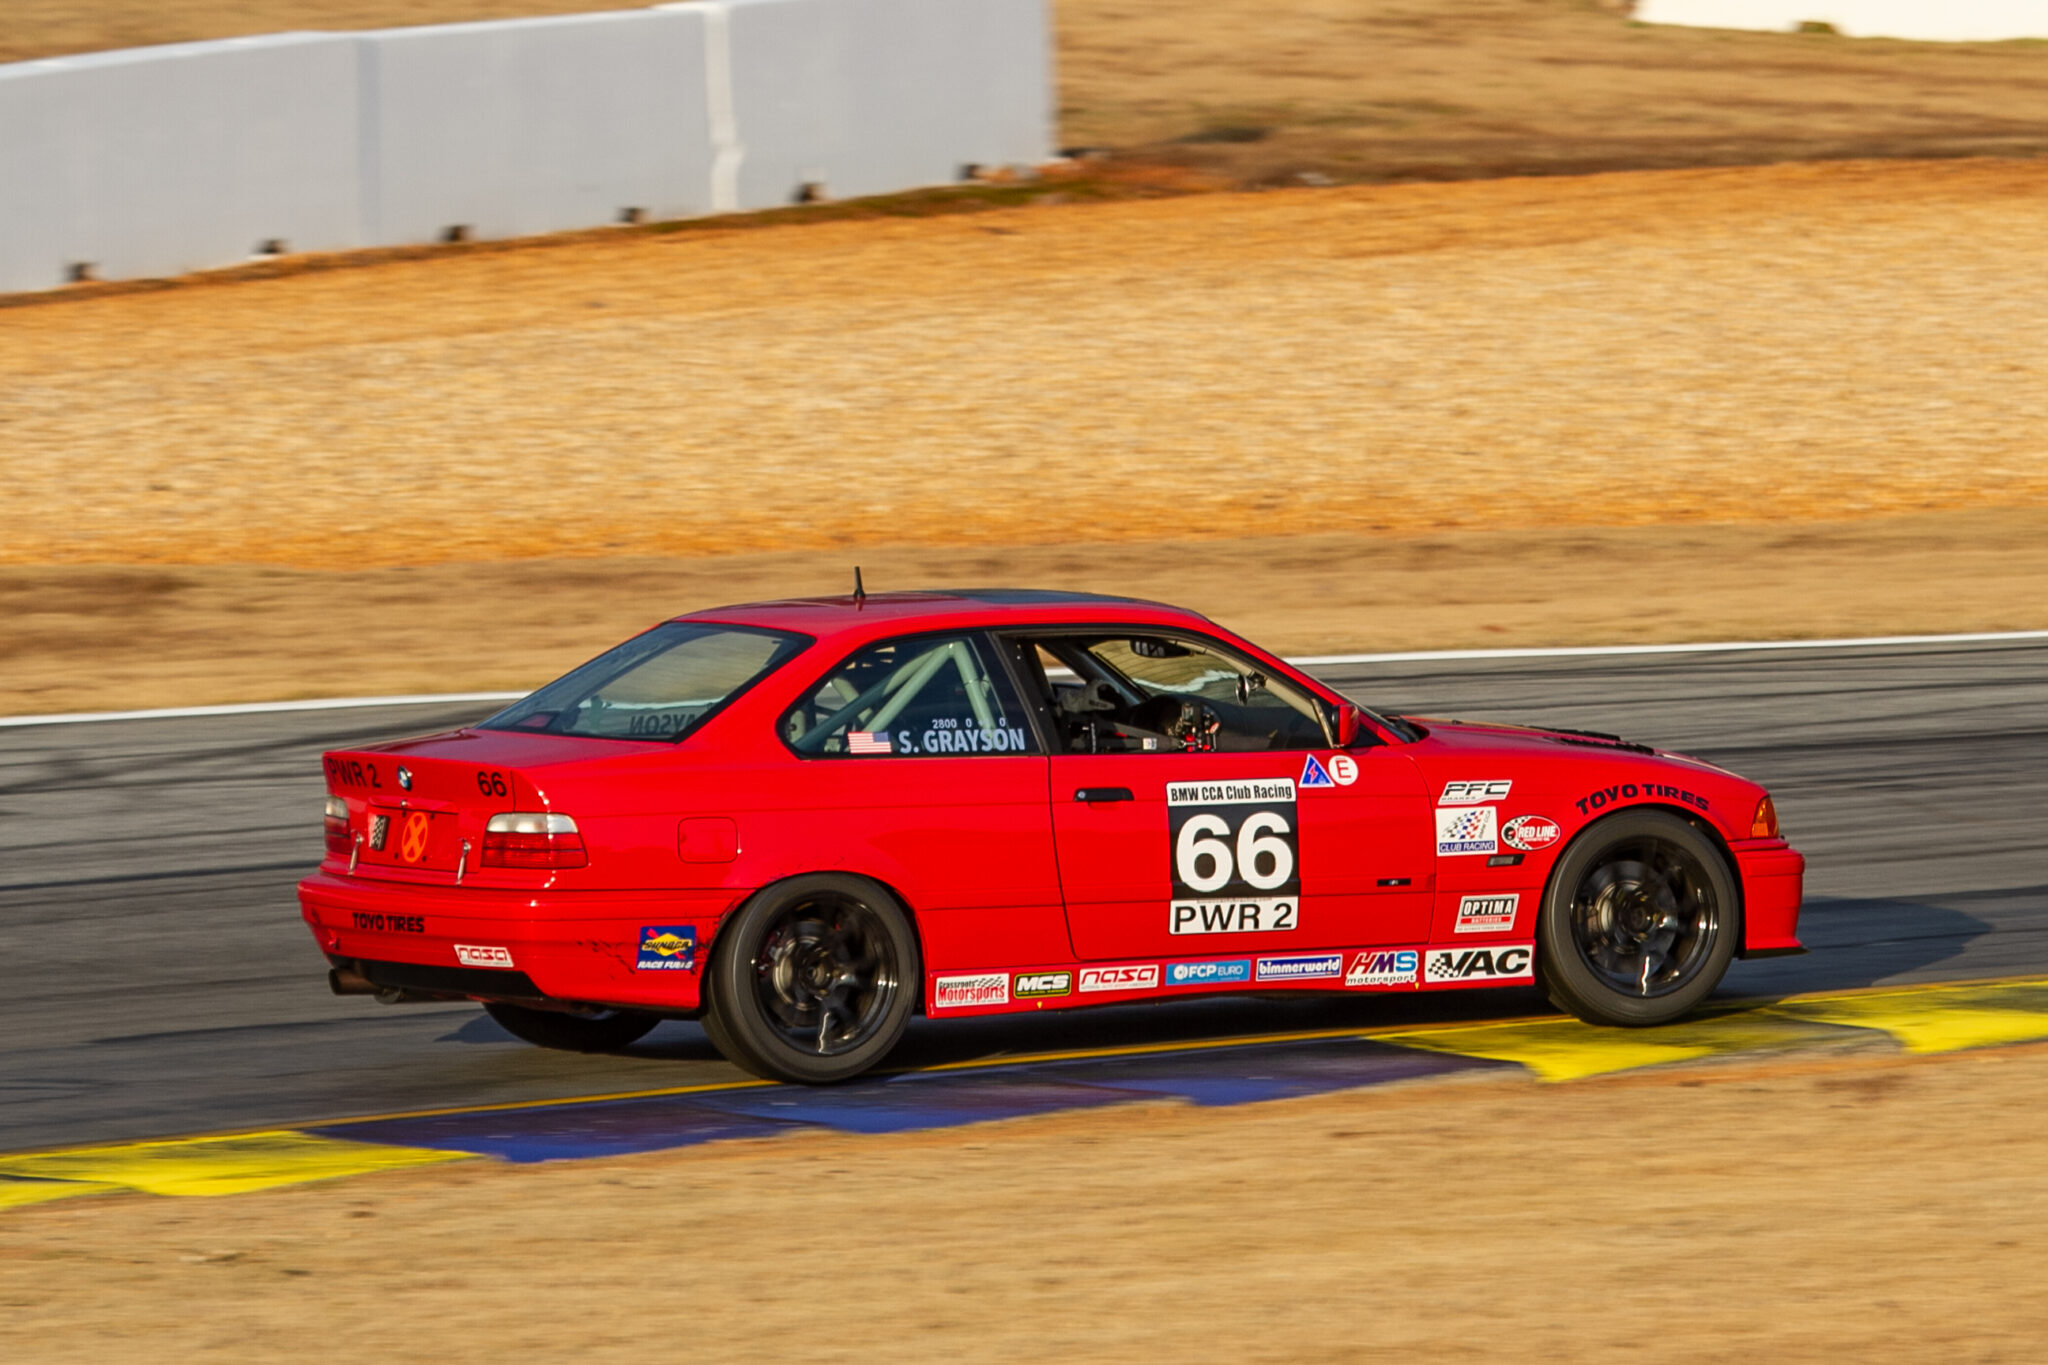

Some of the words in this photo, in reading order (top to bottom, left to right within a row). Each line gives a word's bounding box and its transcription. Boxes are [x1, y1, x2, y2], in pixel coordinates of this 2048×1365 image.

[932, 718, 957, 729] 2800
[898, 731, 919, 754] S.
[923, 728, 1025, 753] GRAYSON
[327, 758, 367, 788] PWR
[366, 763, 382, 788] 2
[1335, 759, 1351, 779] E
[476, 771, 507, 797] 66
[1444, 782, 1510, 796] PFC
[1171, 786, 1199, 802] BMW
[1202, 785, 1224, 801] CCA
[1226, 784, 1250, 800] Club
[1254, 784, 1292, 800] Racing
[1576, 784, 1638, 816] TOYO
[1642, 784, 1709, 811] TIRES
[1518, 826, 1536, 838] RED
[1536, 826, 1557, 838] LINE
[1176, 811, 1293, 892] 66
[1440, 842, 1462, 852] CLUB
[1463, 841, 1495, 851] RACING
[1463, 900, 1512, 915] OPTIMA
[352, 912, 385, 930] TOYO
[386, 915, 425, 933] TIRES
[1174, 903, 1260, 933] PWR
[1273, 902, 1292, 929] 2
[458, 947, 508, 962] nasa
[1348, 951, 1417, 975] HMS
[1434, 948, 1530, 978] VAC
[637, 960, 665, 969] RACE
[1188, 964, 1217, 978] FCP
[1217, 965, 1244, 977] EURO
[1259, 958, 1340, 975] bimmerworld
[938, 980, 976, 989] Grassroots
[1017, 974, 1069, 991] MCS
[1081, 967, 1157, 985] nasa
[1346, 974, 1415, 985] motorsport
[938, 985, 1005, 1002] Motorsports
